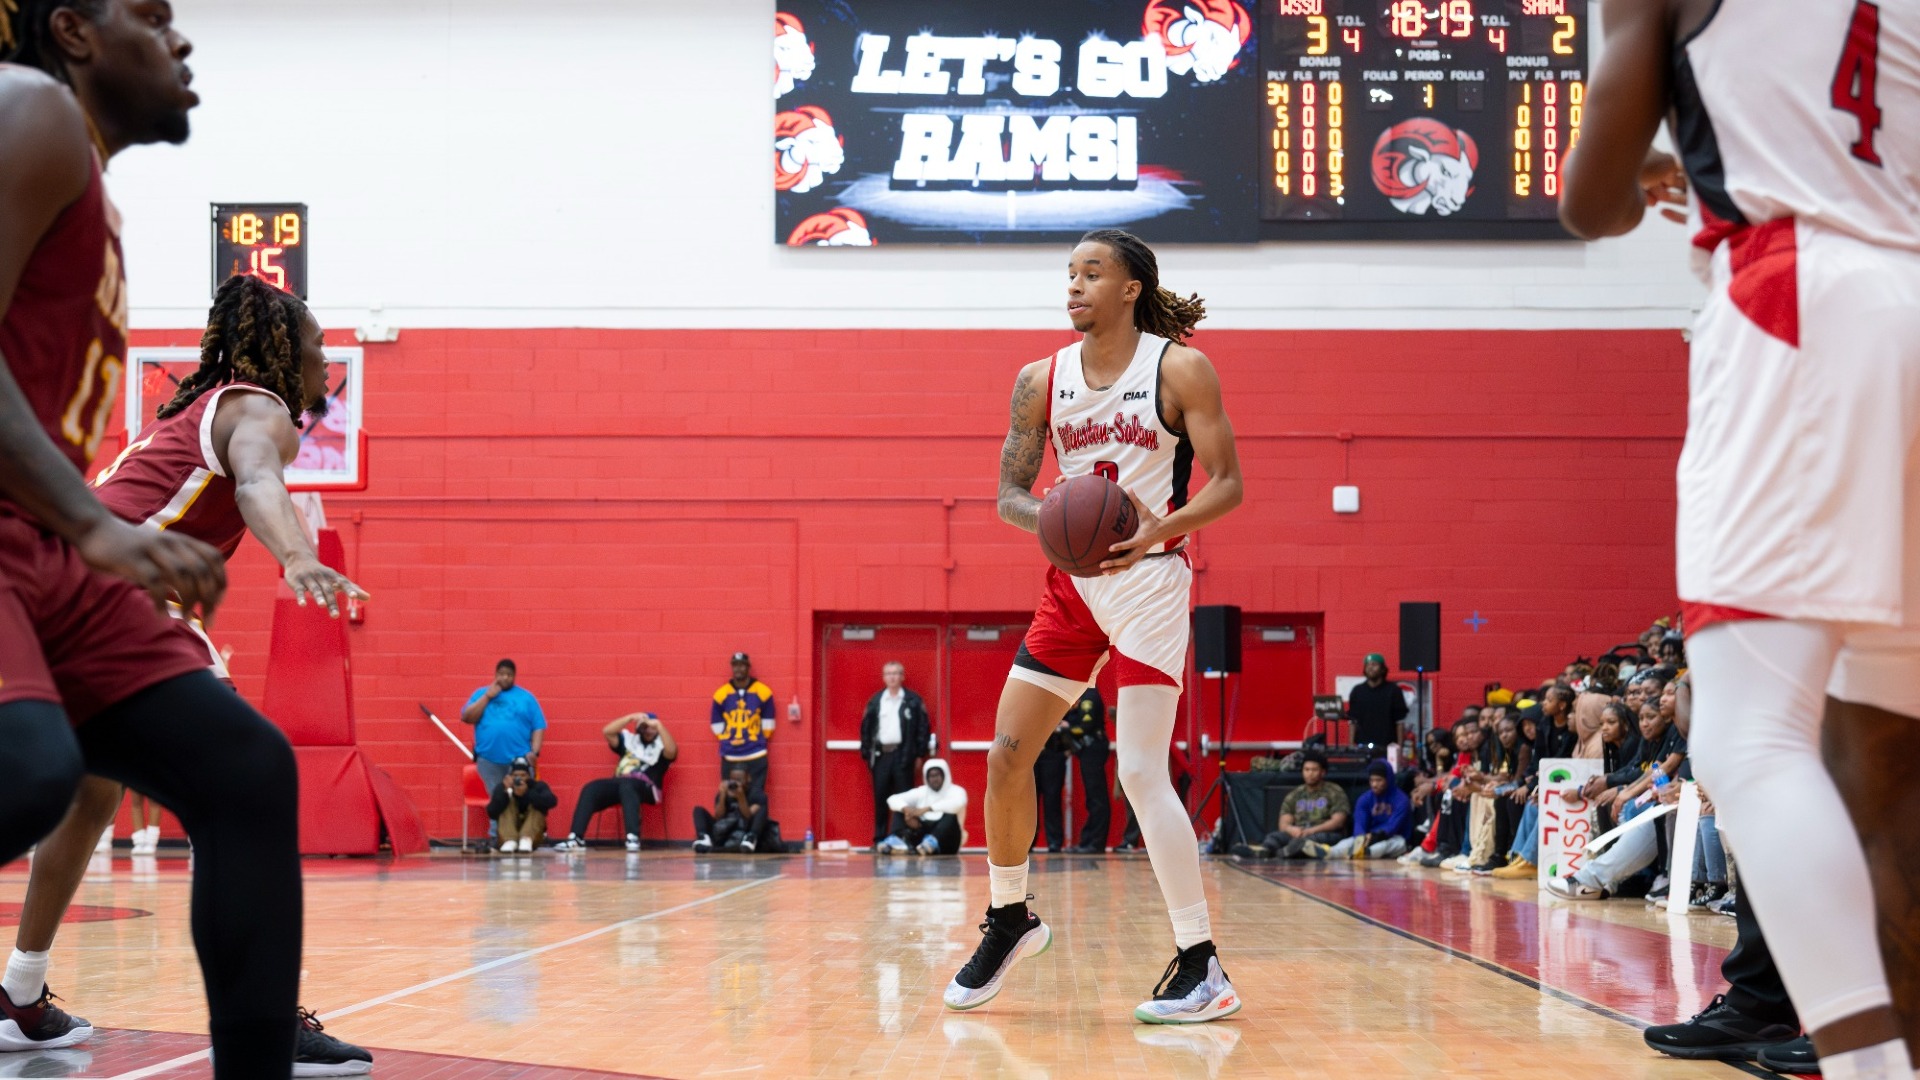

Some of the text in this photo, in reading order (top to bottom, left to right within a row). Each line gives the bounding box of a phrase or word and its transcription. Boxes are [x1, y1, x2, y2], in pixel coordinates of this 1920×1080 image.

[1391, 0, 1471, 37] 18:19
[1307, 16, 1328, 54] 3
[1343, 29, 1360, 52] 4
[1488, 29, 1505, 52] 4
[1552, 15, 1575, 54] 2
[850, 34, 1168, 98] LET'S GO
[1299, 56, 1341, 67] BONUS
[1506, 56, 1549, 67] BONUS
[1267, 70, 1340, 81] PLY FLS PTS
[1363, 70, 1398, 81] FOULS
[1404, 70, 1444, 81] PERIOD
[1451, 70, 1485, 81] FOULS
[1509, 70, 1581, 81] PLY FLS PTS
[1829, 0, 1883, 169] 4
[1267, 82, 1342, 105] 34 0 0
[1523, 82, 1583, 105] 1 0 0
[1276, 105, 1342, 128] 5 0 0
[1517, 105, 1582, 127] 0 0 0
[1273, 128, 1342, 150] 11 0 0
[1544, 128, 1556, 150] 0
[1276, 151, 1342, 174] 0 0 0
[1515, 151, 1556, 173] 11 0
[1276, 174, 1342, 196] 4 0 3
[1544, 173, 1556, 196] 0
[232, 213, 299, 245] 18:19
[251, 247, 285, 290] 15
[1123, 391, 1148, 401] CIAA
[1057, 412, 1160, 455] Winston-Salem
